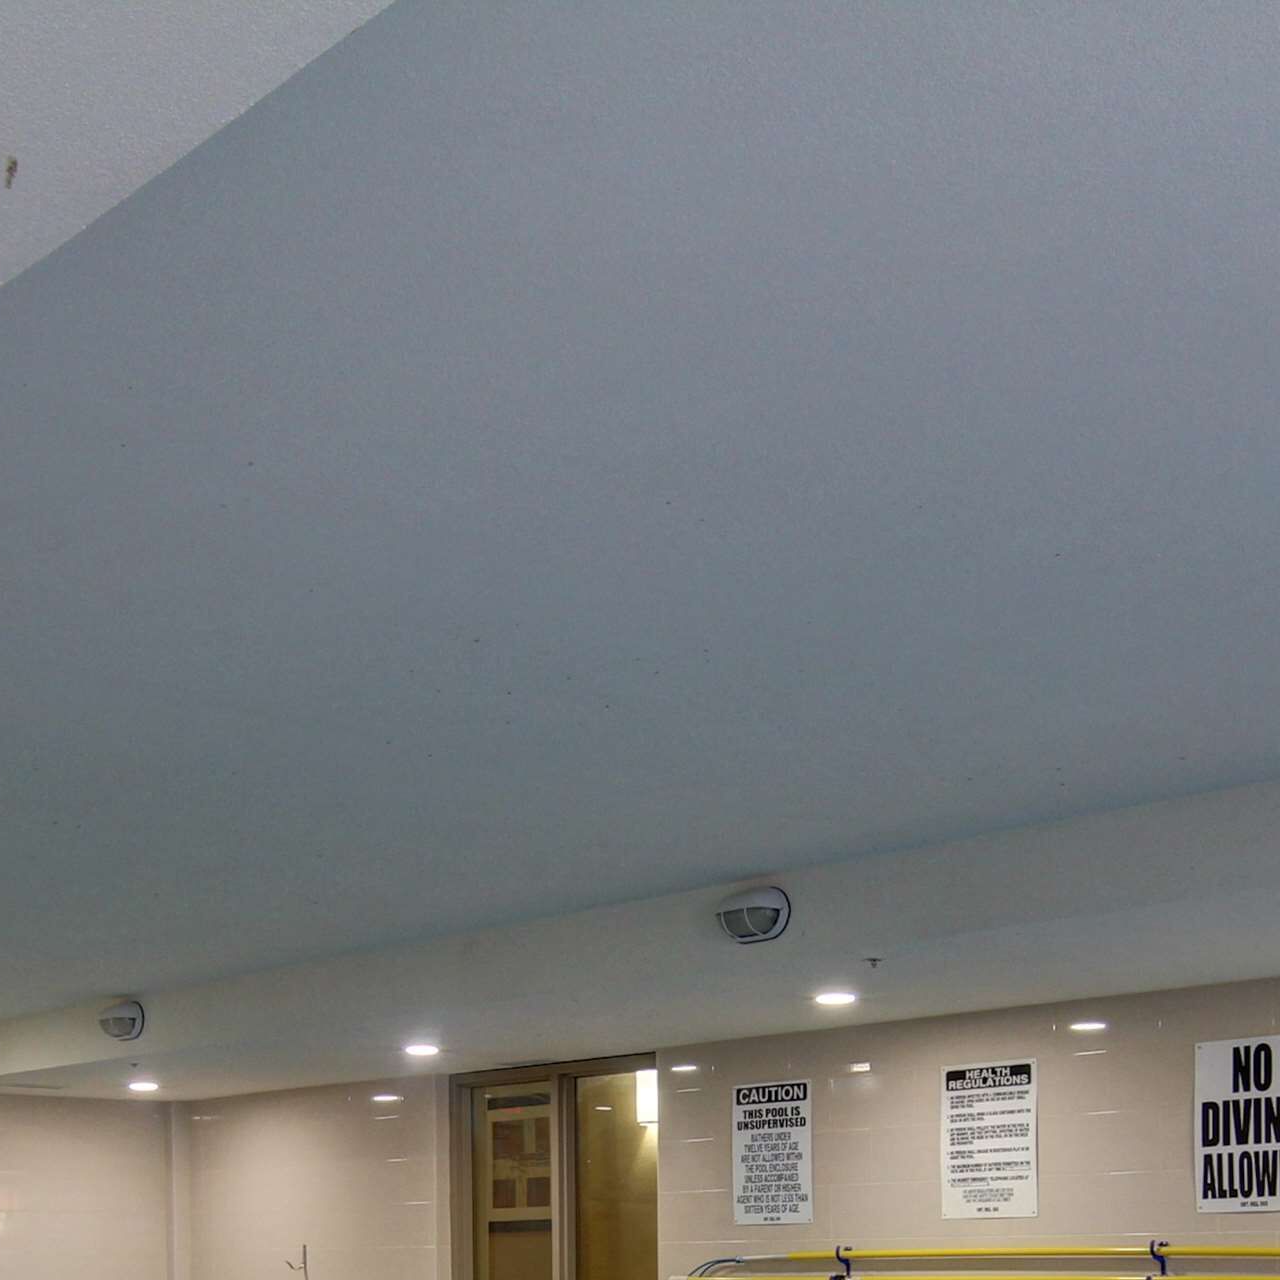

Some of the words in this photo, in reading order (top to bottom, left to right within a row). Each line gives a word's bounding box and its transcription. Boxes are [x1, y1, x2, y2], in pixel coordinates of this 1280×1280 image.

[966, 1067, 1010, 1080] HEALTH
[1232, 1042, 1273, 1093] NO
[948, 1074, 1028, 1090] REGULATIONS
[739, 1085, 804, 1104] CAUTION
[742, 1109, 763, 1120] THIS
[765, 1107, 789, 1118] POOL
[791, 1106, 800, 1116] IS
[737, 1116, 806, 1131] UNSUPERVISED
